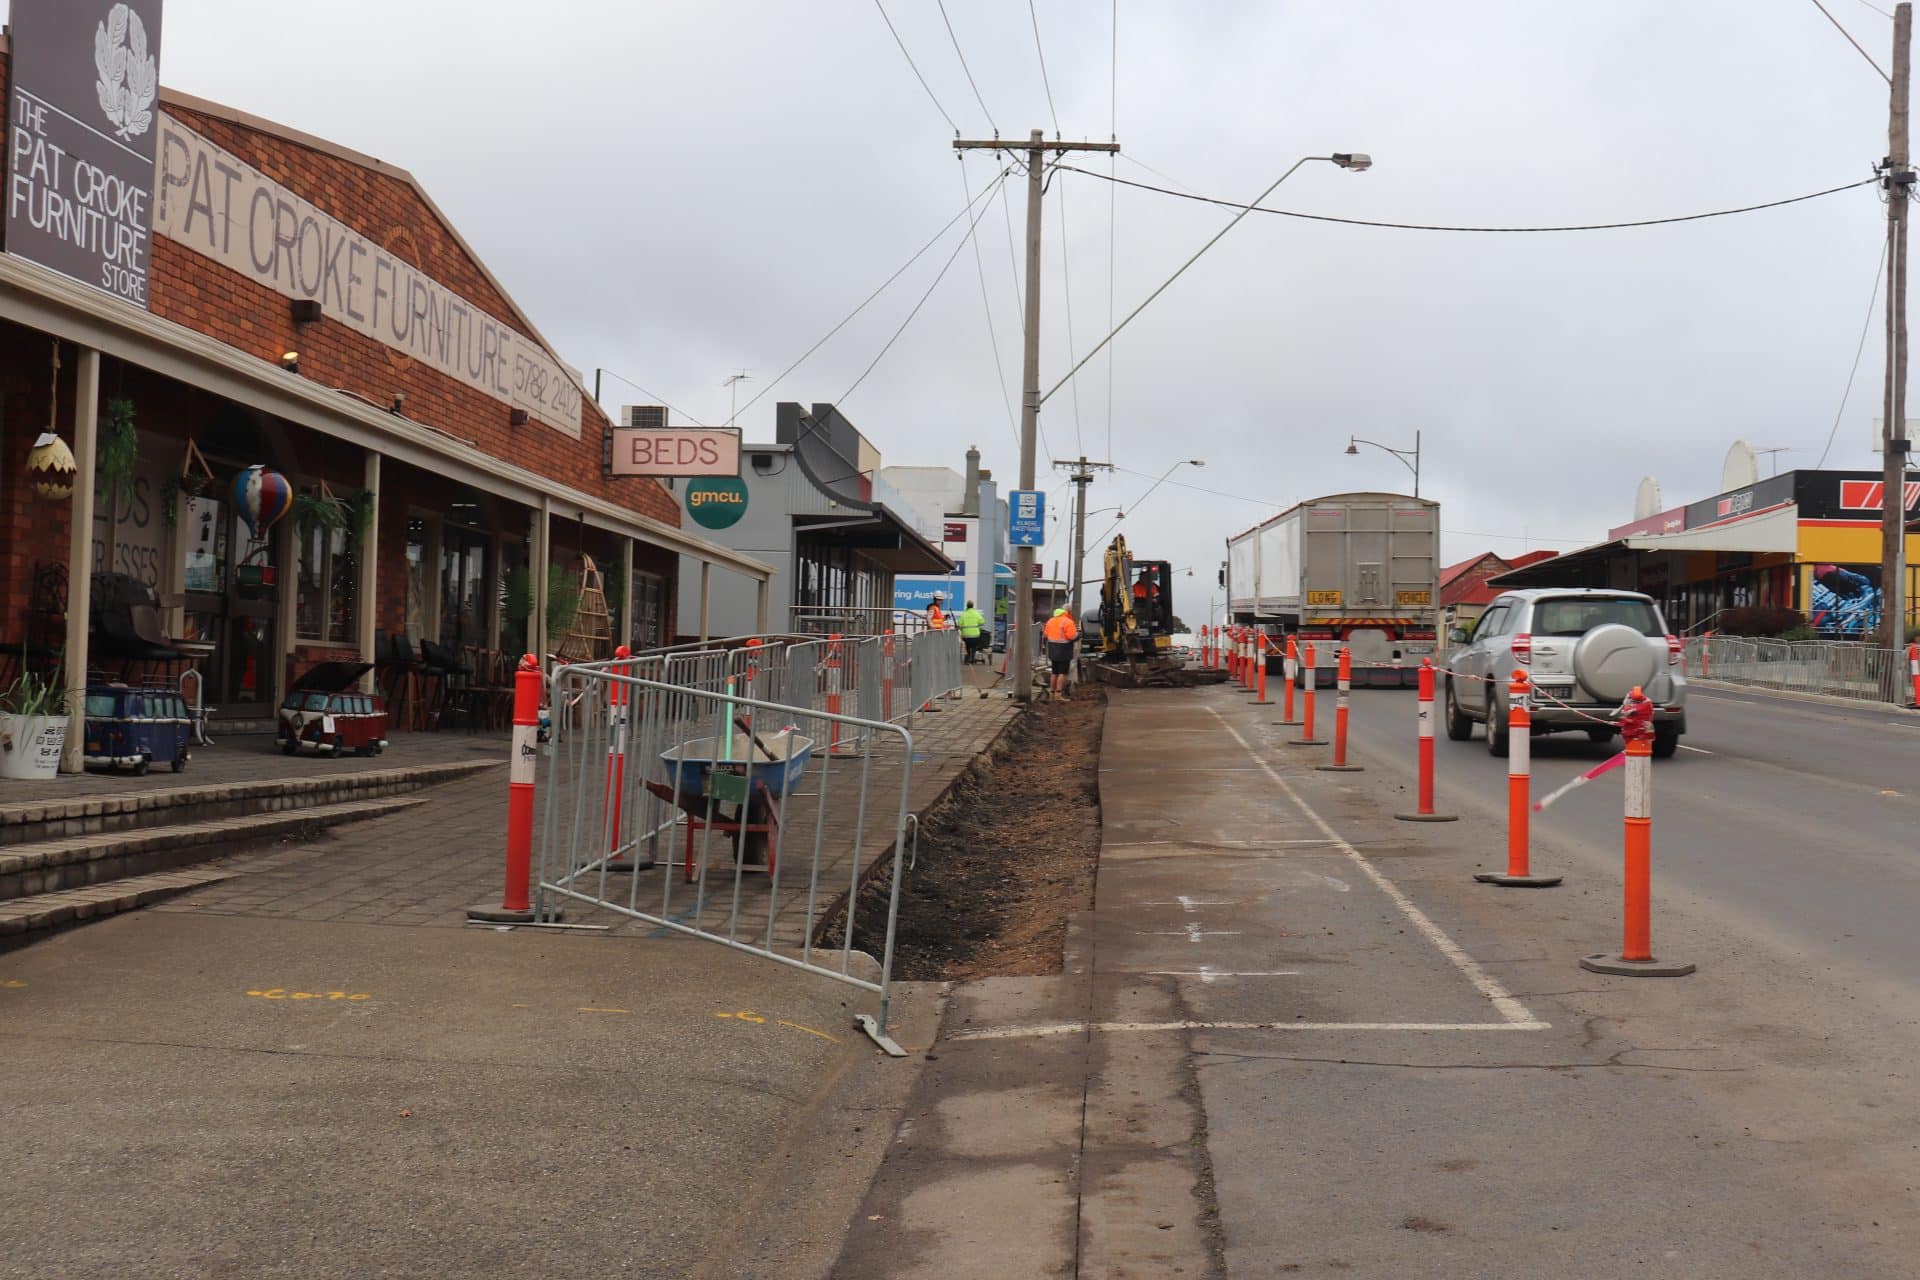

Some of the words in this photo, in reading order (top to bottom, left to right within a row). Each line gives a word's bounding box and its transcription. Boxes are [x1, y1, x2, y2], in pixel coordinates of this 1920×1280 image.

[15, 95, 48, 137] THE
[14, 126, 65, 190] PAT
[75, 160, 147, 232] CROKE
[12, 177, 146, 275] FURNITURE
[102, 261, 146, 302] STORE
[159, 128, 242, 255] PAT
[249, 185, 368, 322] CROKE
[371, 255, 511, 396] FURNITURE
[514, 353, 548, 405] 5782
[632, 437, 719, 465] BEDS
